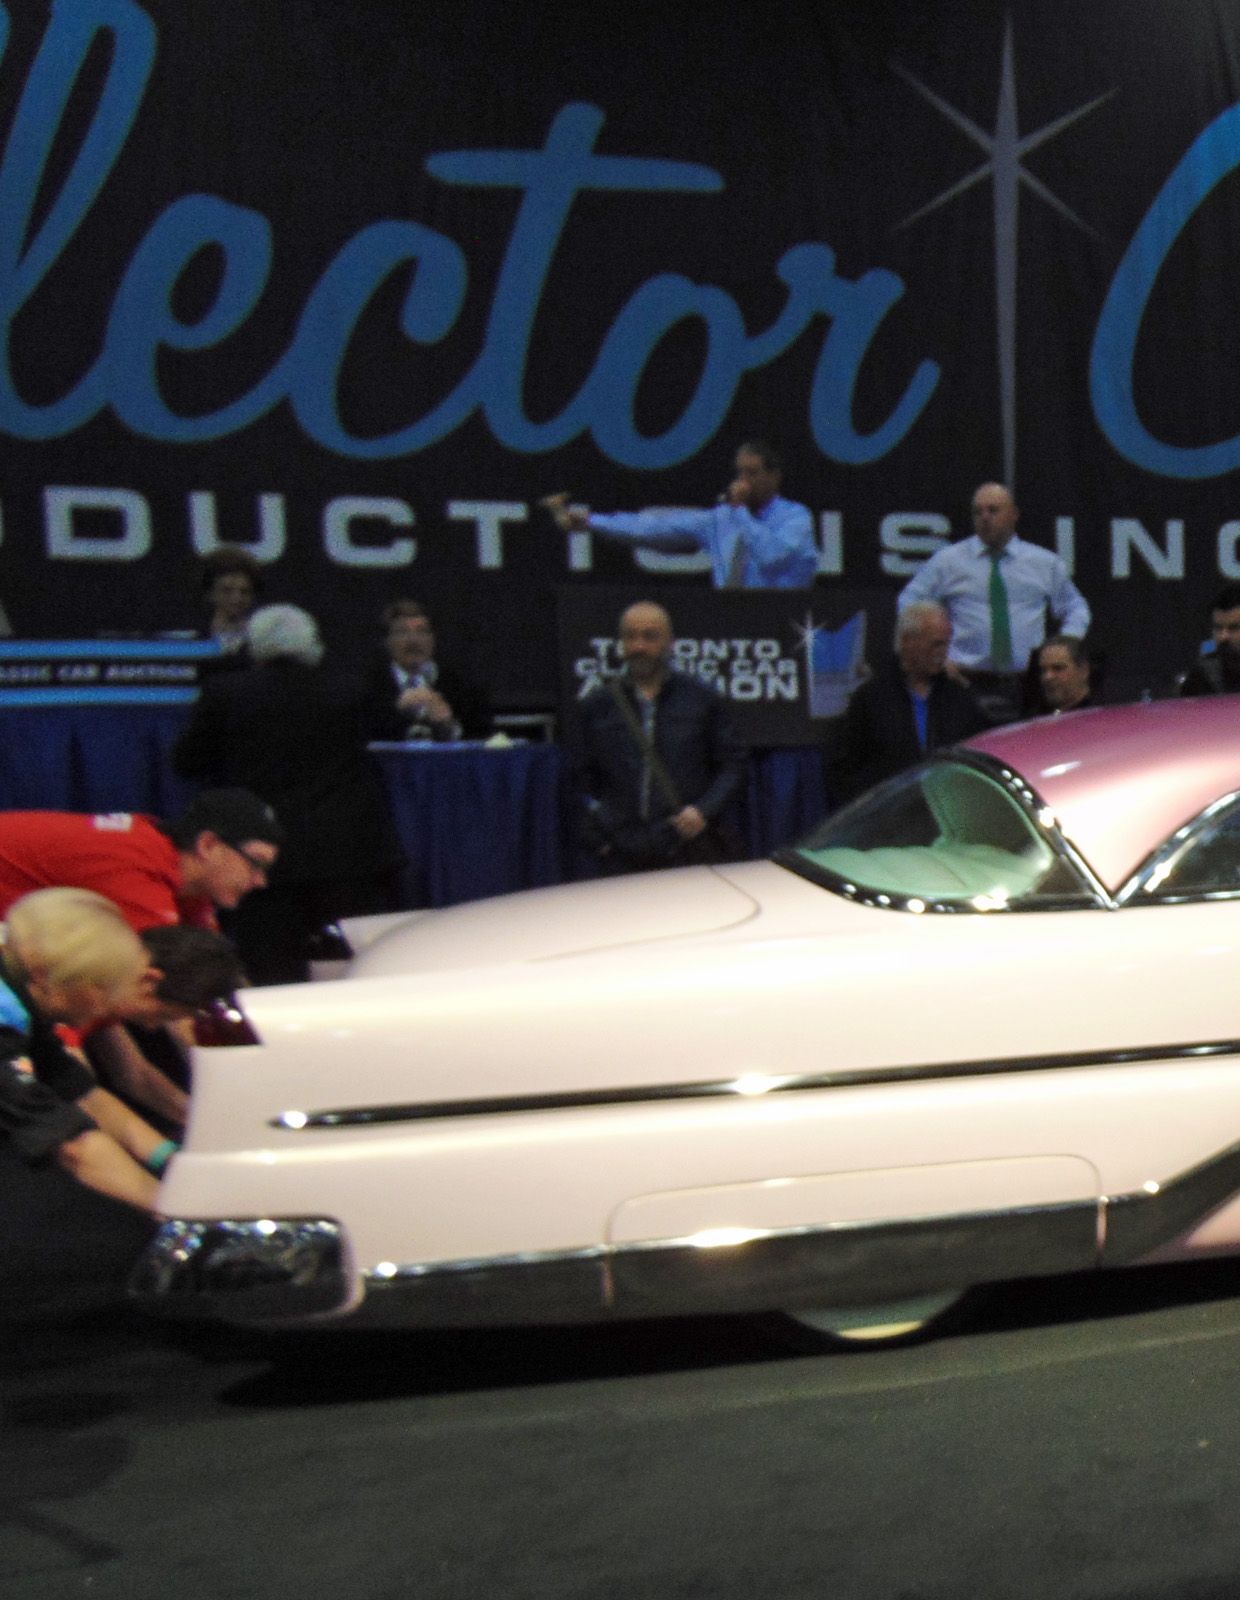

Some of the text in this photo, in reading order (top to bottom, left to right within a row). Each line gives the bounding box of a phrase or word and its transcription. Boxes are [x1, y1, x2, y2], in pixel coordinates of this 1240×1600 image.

[0, 0, 941, 469] lector
[590, 637, 781, 660] TONTO
[731, 659, 798, 677] CAR
